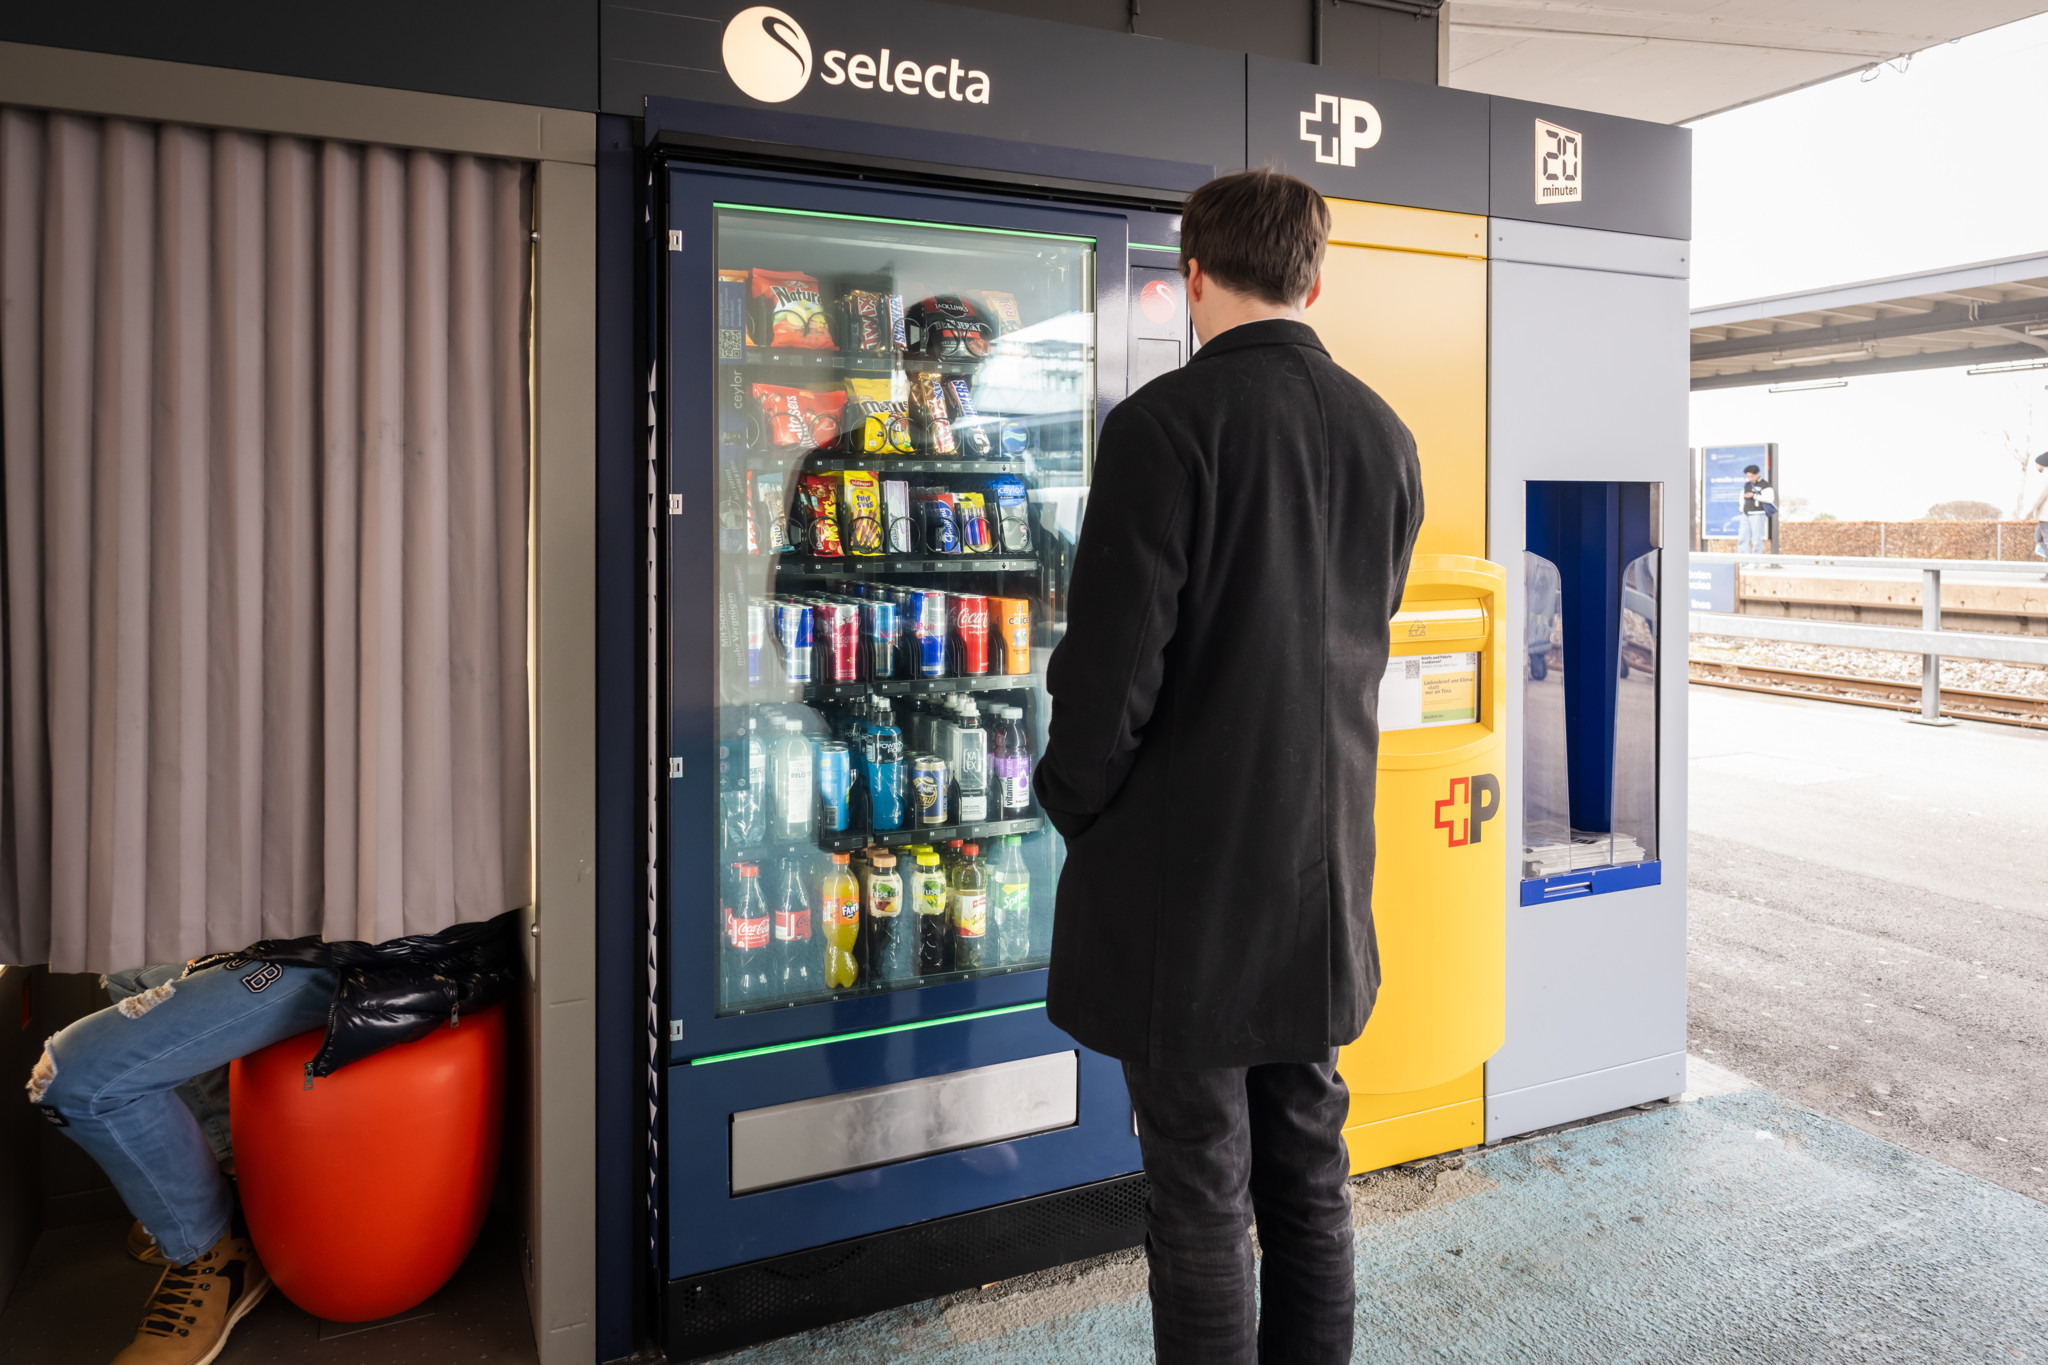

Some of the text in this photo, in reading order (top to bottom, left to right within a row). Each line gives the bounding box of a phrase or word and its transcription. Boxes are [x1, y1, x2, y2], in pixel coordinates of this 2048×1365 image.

[820, 48, 991, 104] selecta
[1543, 129, 1578, 181] 20
[1542, 183, 1578, 198] minuten
[858, 296, 880, 350] TWIX
[888, 295, 906, 344] SNICKERS
[730, 370, 745, 409] ceylor
[952, 380, 983, 431] SICKERS
[998, 486, 1025, 498] ceylor
[773, 524, 784, 547] KIND
[940, 508, 957, 543] Smokng
[966, 761, 977, 770] EX
[967, 751, 977, 760] KA
[240, 961, 283, 994] B
